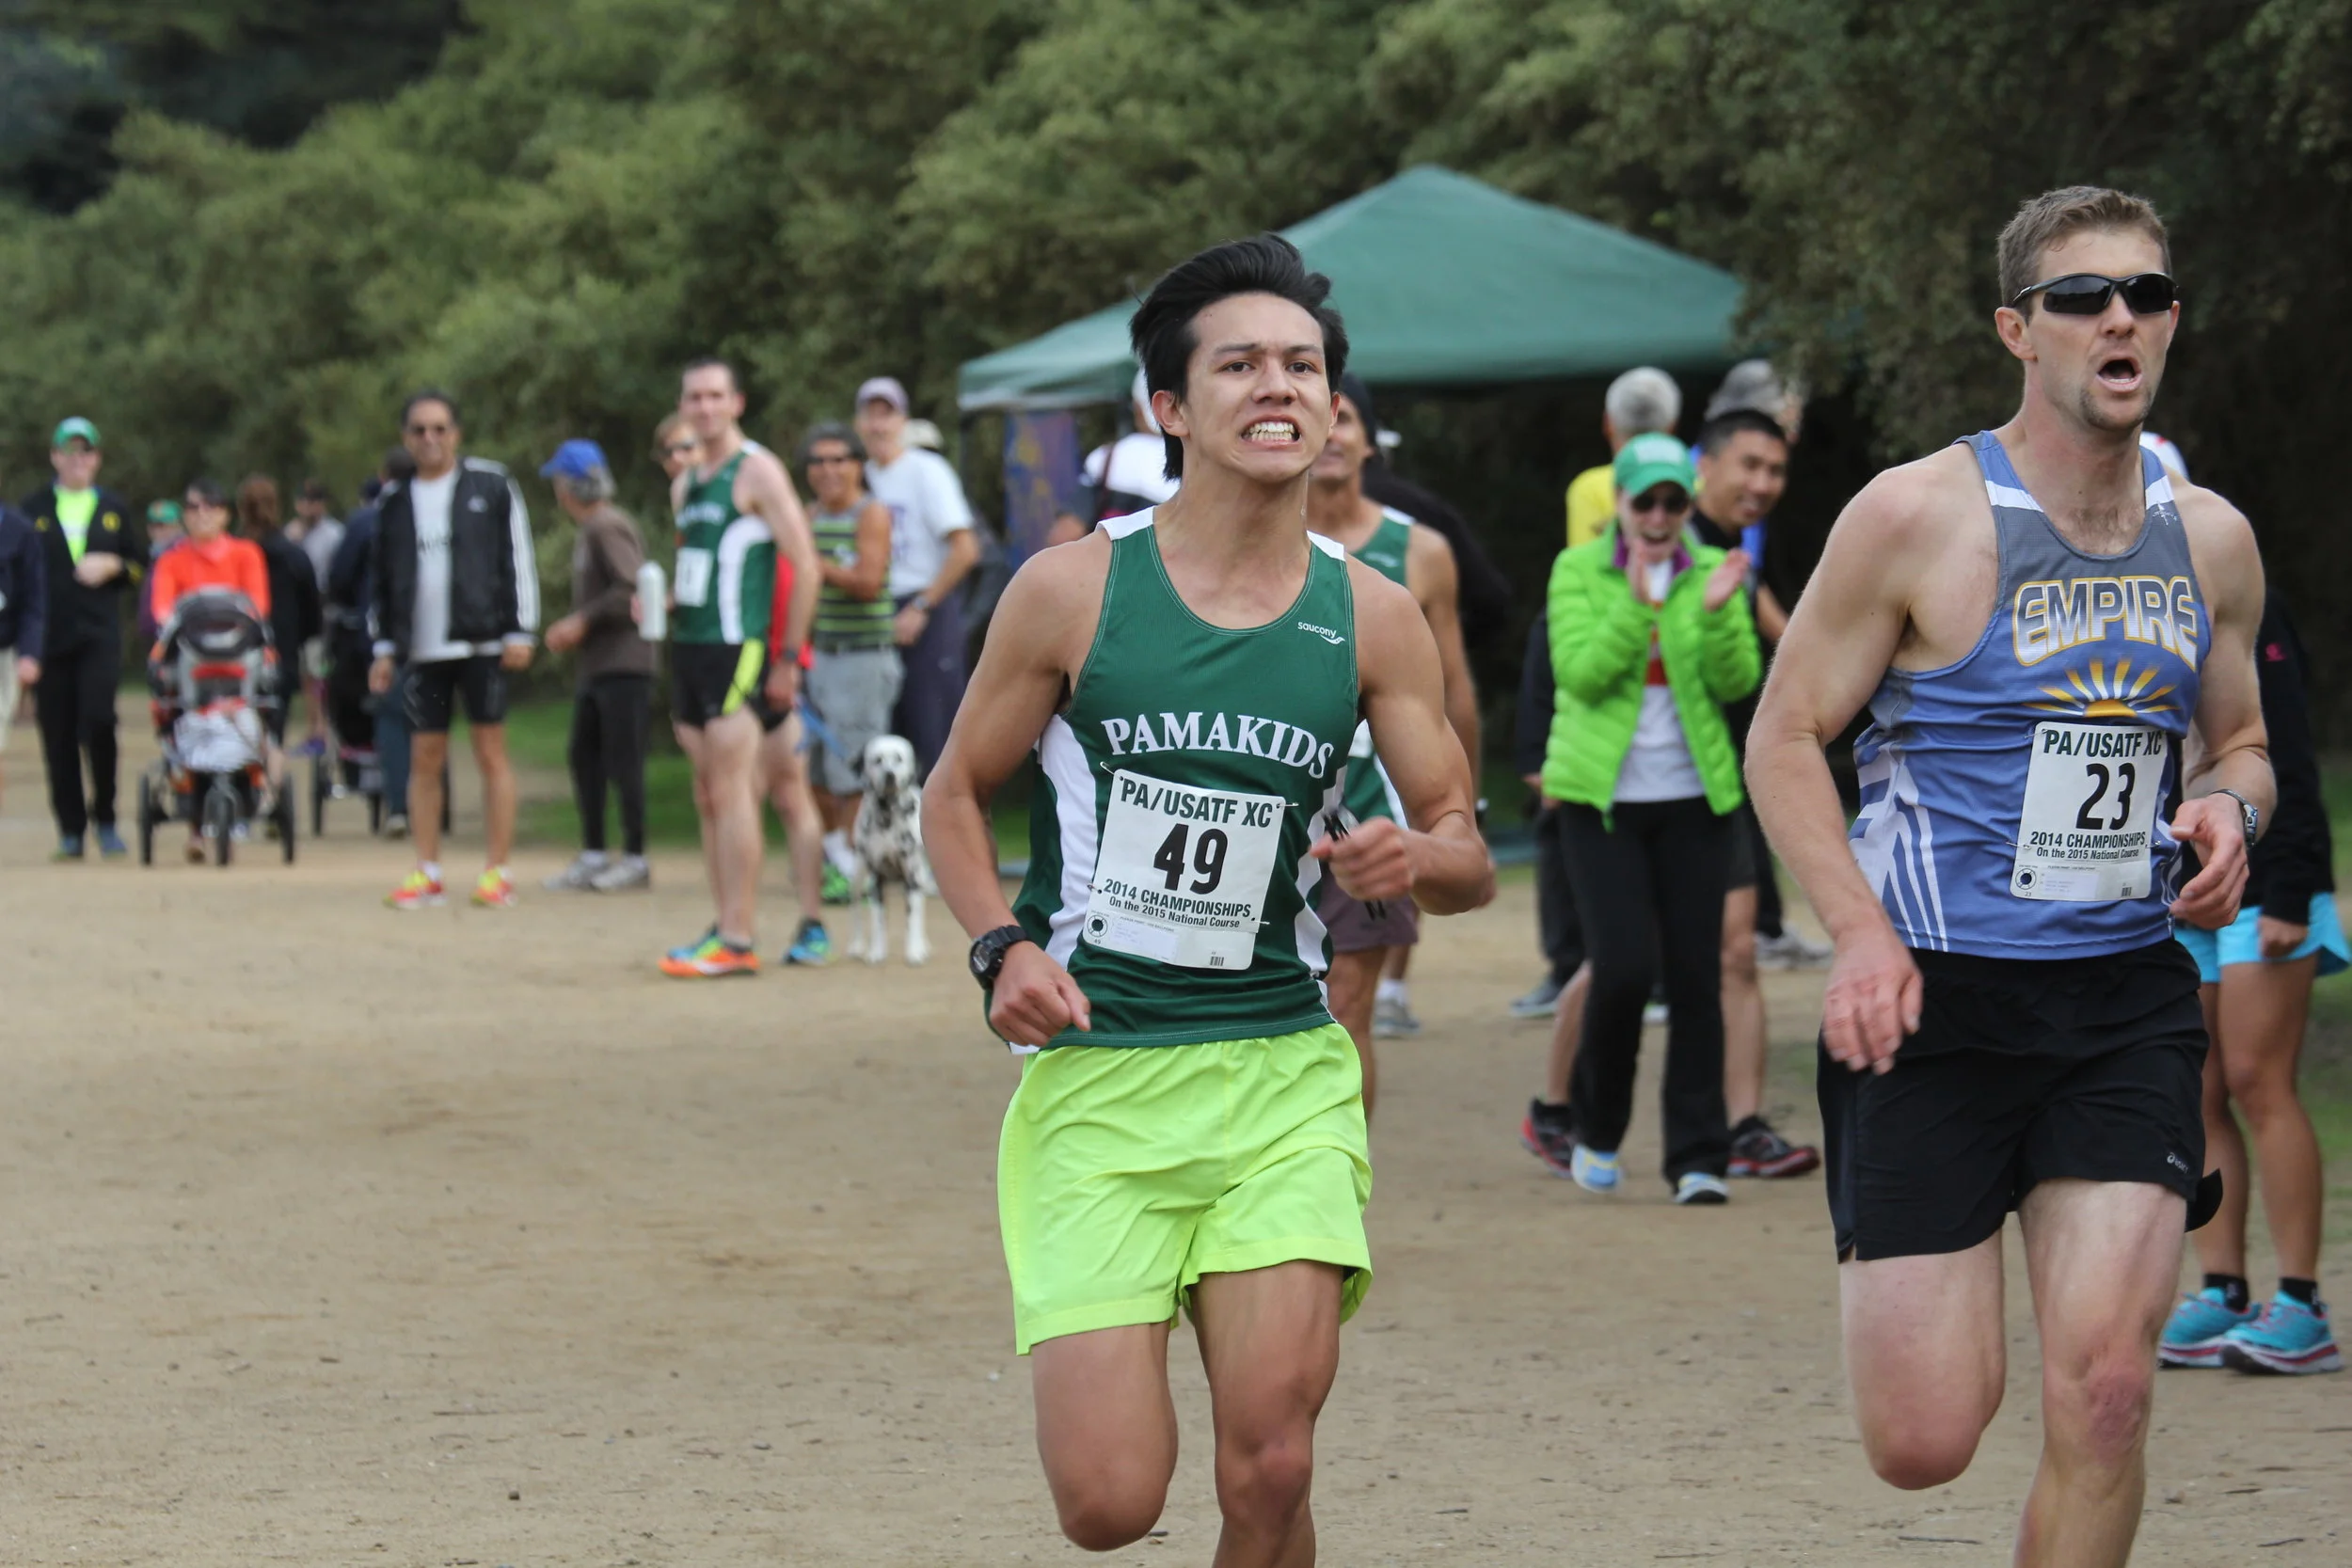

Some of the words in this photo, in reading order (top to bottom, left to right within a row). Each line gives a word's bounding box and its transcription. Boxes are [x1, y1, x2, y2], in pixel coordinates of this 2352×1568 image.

[1297, 621, 1337, 639] saucony
[2012, 576, 2198, 673] EMPIRE
[1101, 712, 1334, 779] PAMAKIDS
[2043, 729, 2141, 758] PA/USATF
[2142, 731, 2162, 756] XC
[1120, 779, 1237, 824] PA/USATF
[1241, 801, 1273, 828] XC
[2075, 762, 2136, 830] 23
[1153, 823, 1228, 895] 49
[2030, 832, 2062, 847] 2014
[2067, 832, 2145, 848] CHAMPIONSHIPS
[2037, 847, 2049, 857] On
[2051, 847, 2065, 858] the
[2067, 848, 2089, 859] 2015
[2090, 848, 2119, 860] National
[2121, 848, 2139, 858] Course
[1103, 879, 1136, 900] 2014
[1140, 890, 1251, 918] CHAMPIONSHIPS
[1109, 895, 1122, 908] On
[1124, 900, 1139, 912] the
[1142, 905, 1166, 919] 2015
[1168, 911, 1207, 927] National
[1209, 916, 1240, 927] Course
